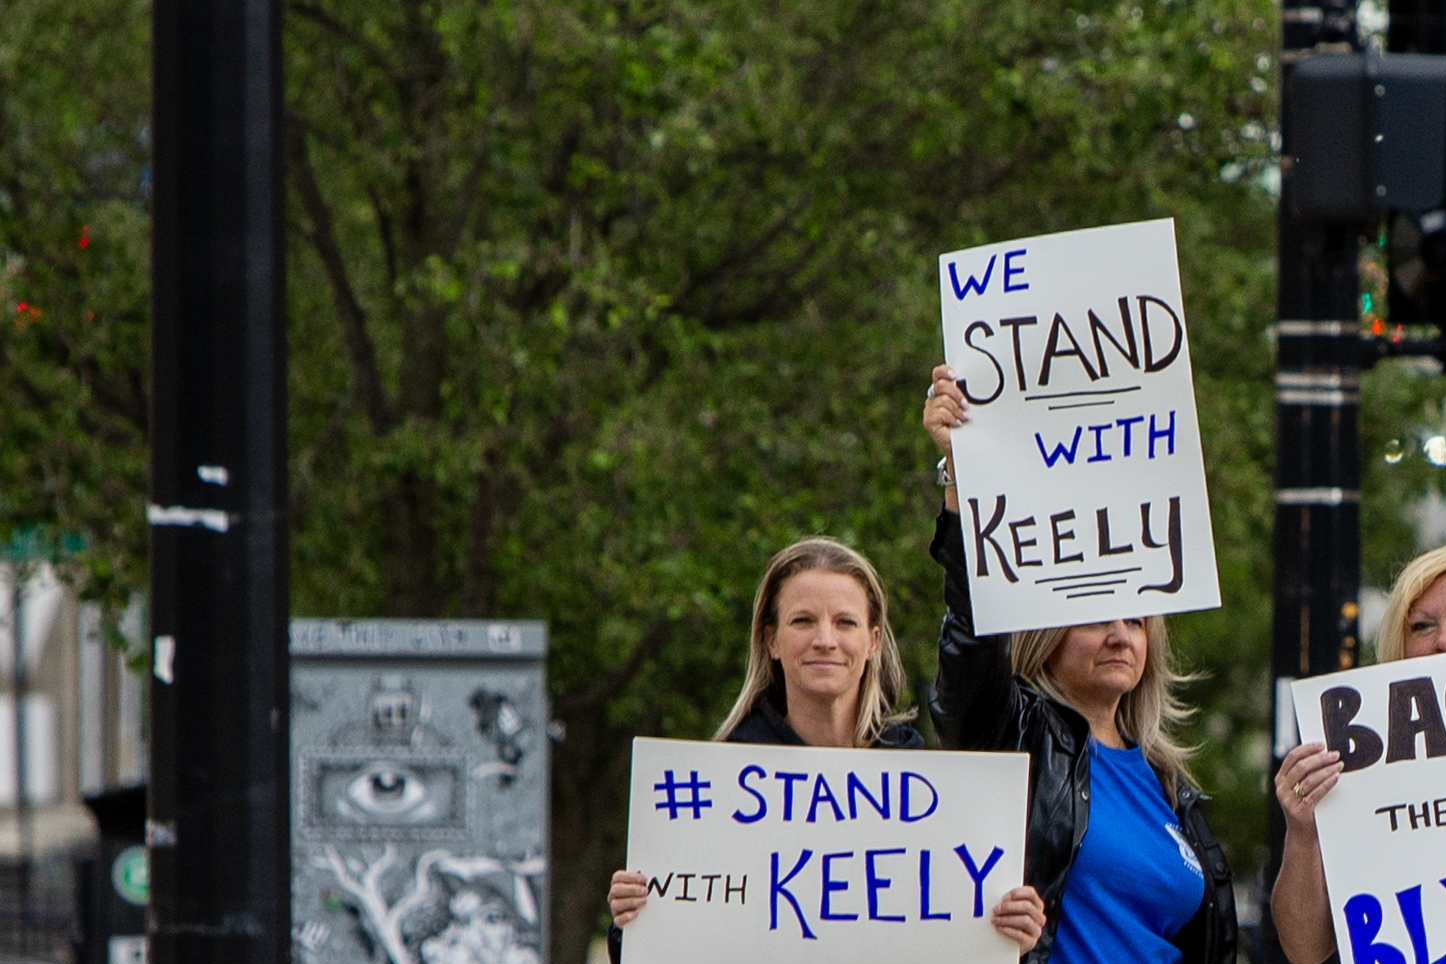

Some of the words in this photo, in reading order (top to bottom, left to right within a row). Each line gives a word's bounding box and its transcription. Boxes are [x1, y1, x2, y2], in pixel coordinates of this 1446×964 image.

[948, 249, 1029, 300] WE
[956, 295, 1183, 405] STAND
[1035, 411, 1176, 468] WITH
[967, 494, 1184, 595] KEELY
[731, 765, 939, 823] STAND
[769, 844, 1005, 939] KEELY
